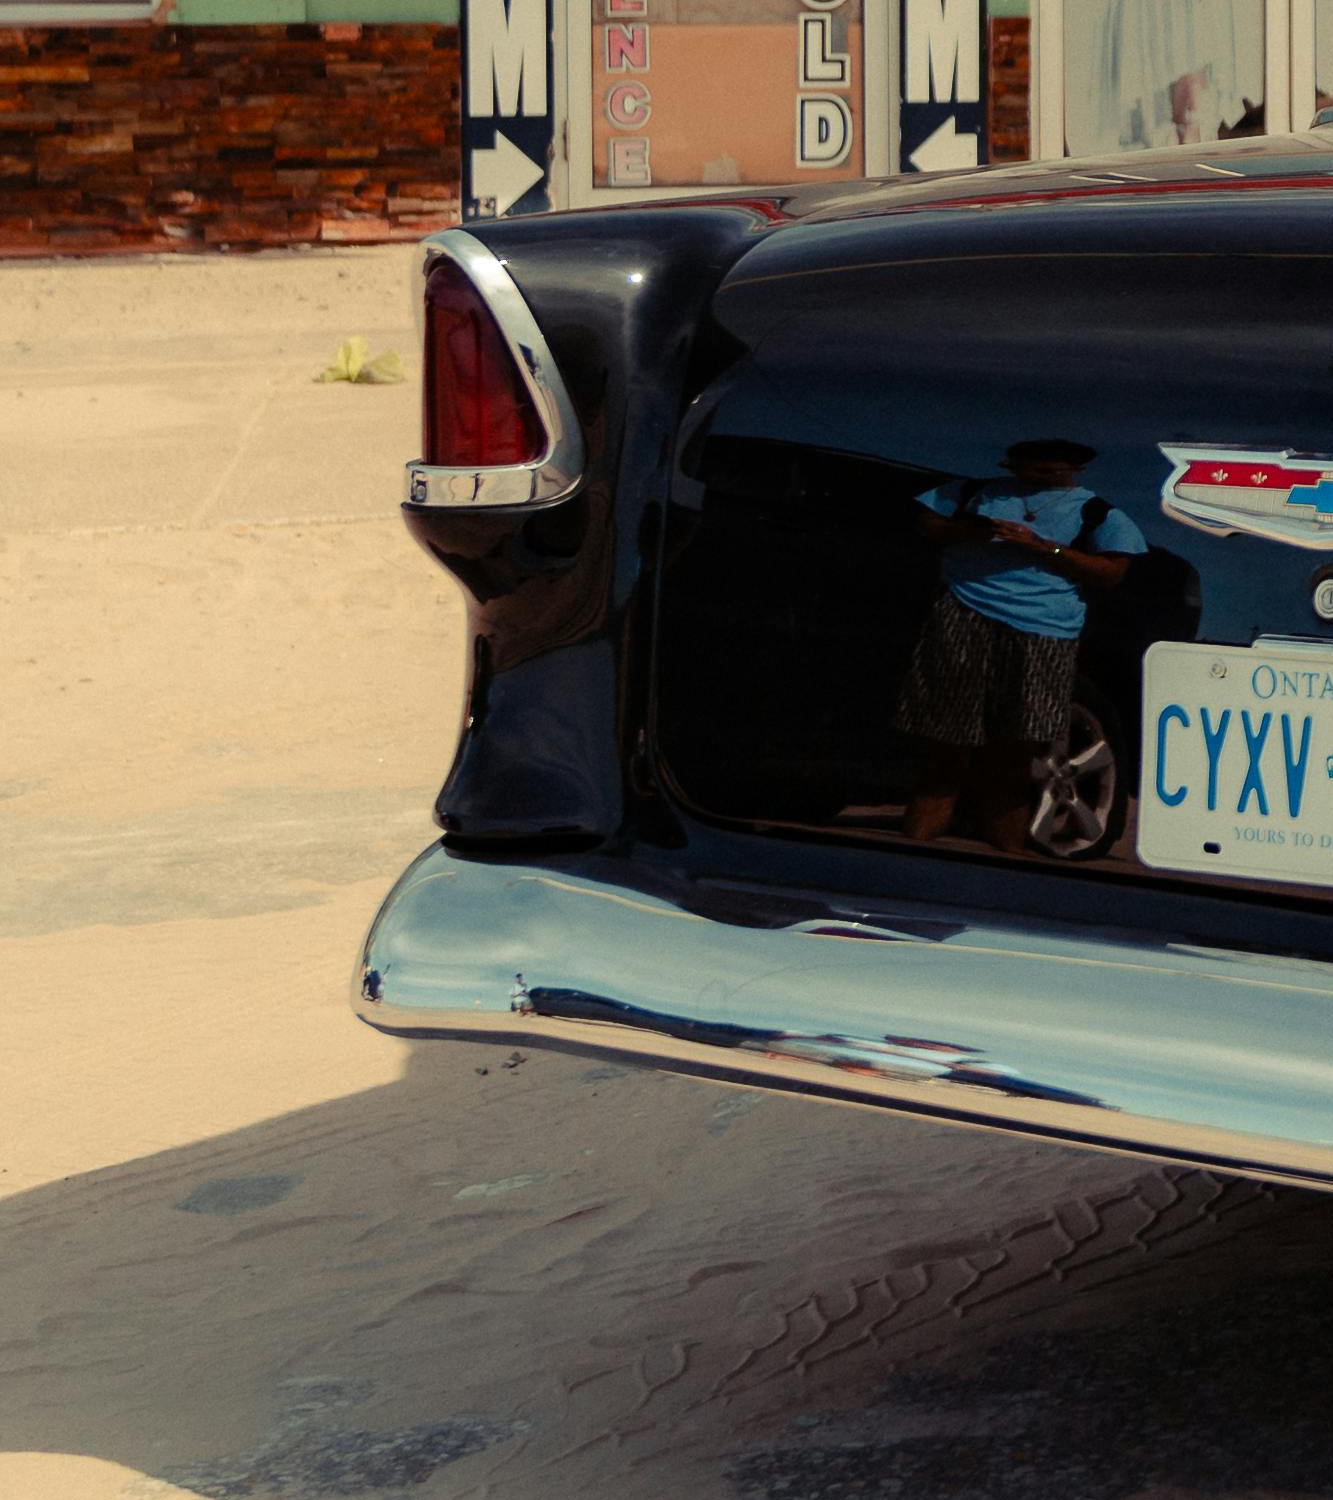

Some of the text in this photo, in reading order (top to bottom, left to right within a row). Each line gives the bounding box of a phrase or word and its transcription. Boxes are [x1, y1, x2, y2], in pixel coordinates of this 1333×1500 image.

[1155, 703, 1312, 819] CYXV
[1234, 826, 1286, 845] YOURS
[1292, 831, 1314, 847] TO
